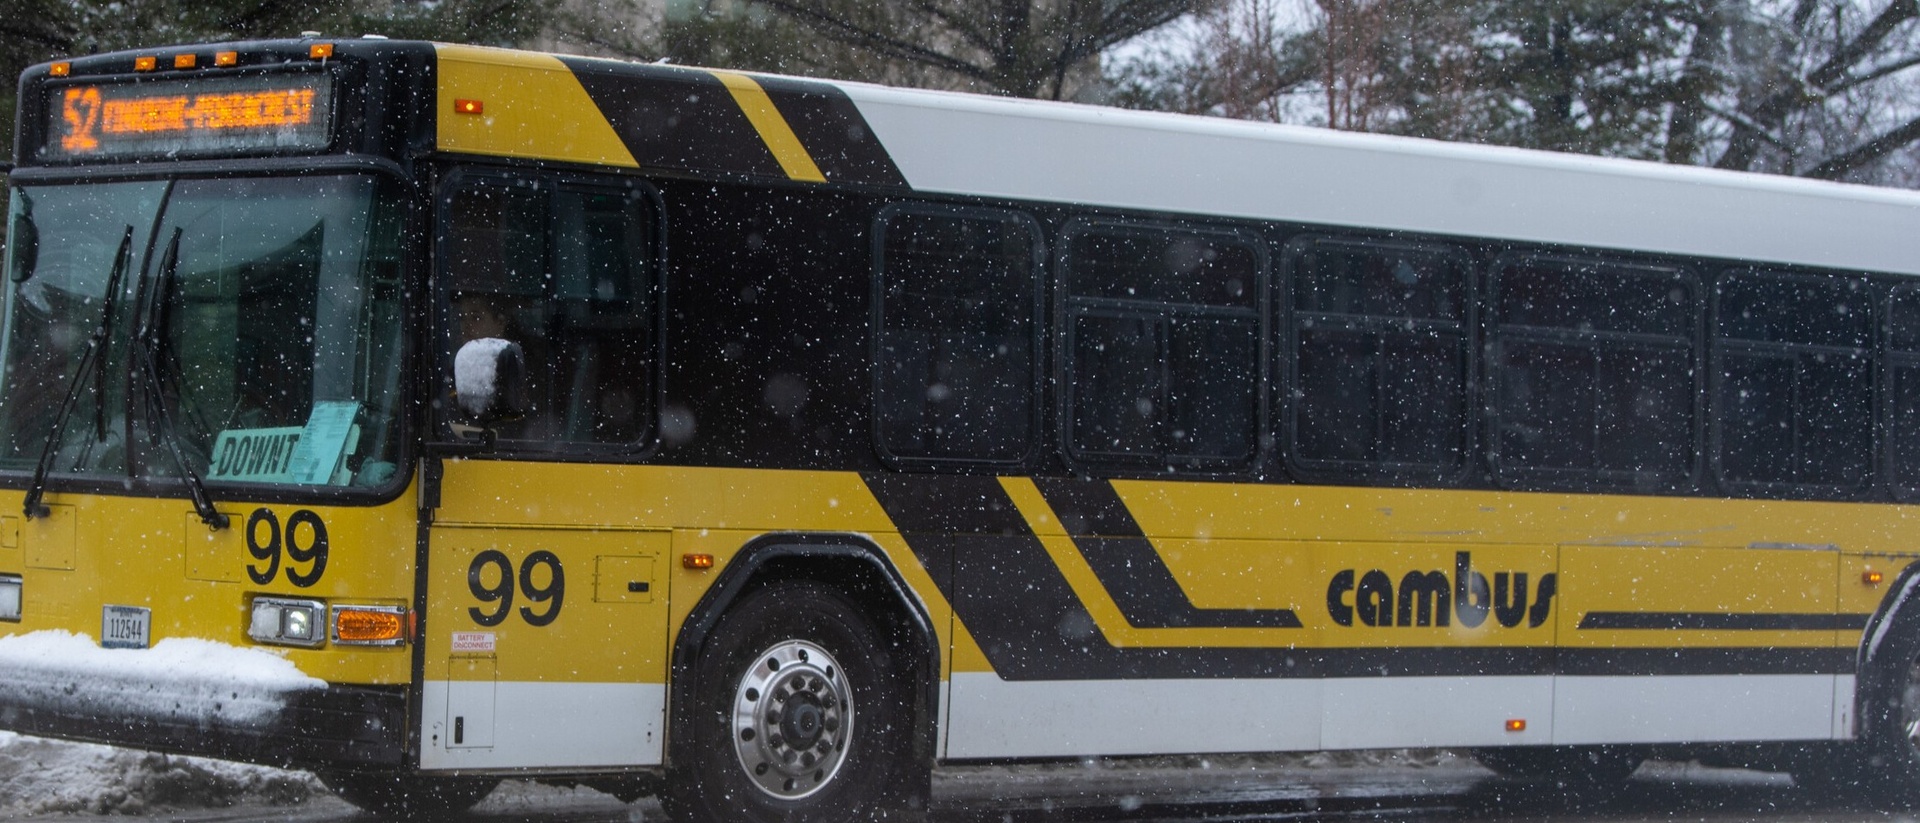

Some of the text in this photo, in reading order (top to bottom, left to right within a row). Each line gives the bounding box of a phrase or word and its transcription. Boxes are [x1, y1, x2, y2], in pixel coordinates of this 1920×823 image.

[216, 433, 343, 476] DOWNT
[246, 508, 328, 587] 99
[468, 550, 565, 627] 99
[1327, 551, 1557, 628] cambus
[110, 618, 142, 639] 112544
[453, 641, 493, 649] DISCONNECT
